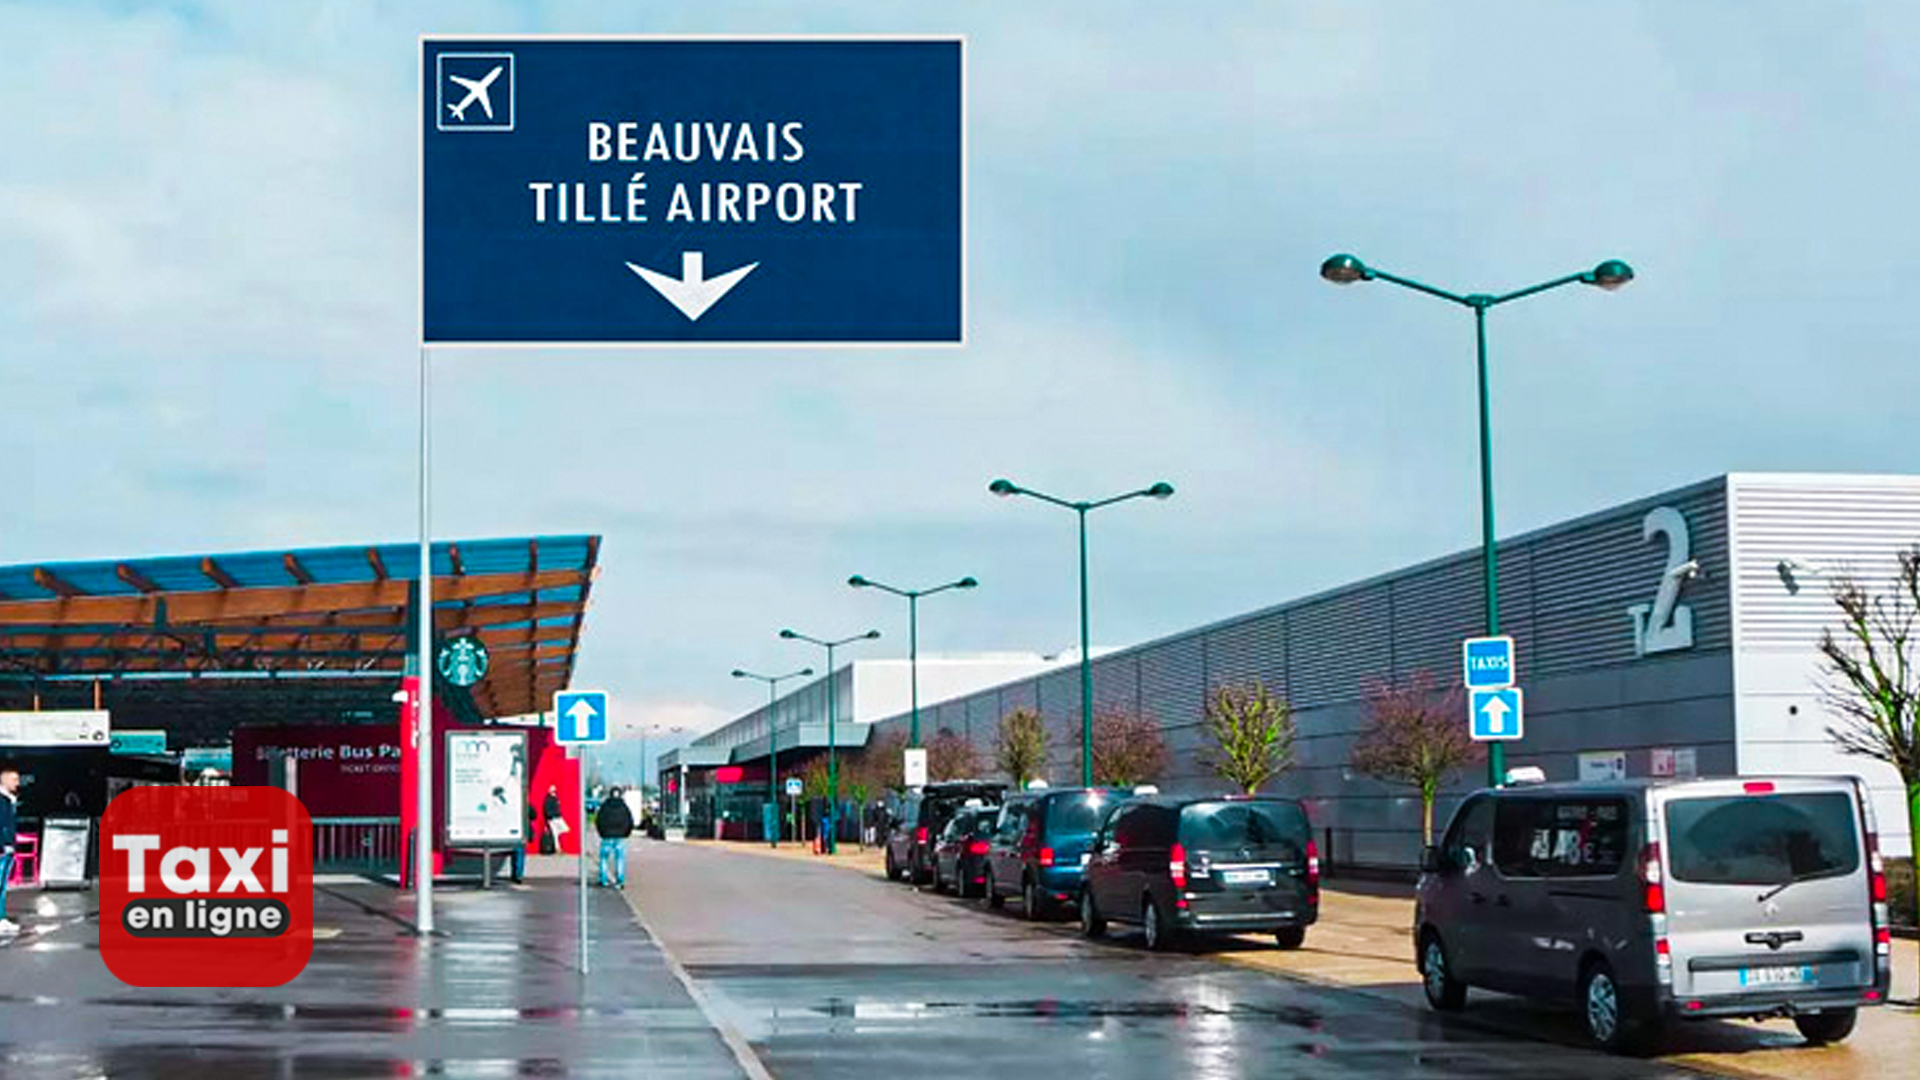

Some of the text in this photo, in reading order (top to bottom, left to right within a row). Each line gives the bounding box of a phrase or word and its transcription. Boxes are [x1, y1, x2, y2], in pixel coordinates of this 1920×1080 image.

[587, 121, 805, 163] BEAUVAIS
[529, 172, 864, 223] TILLÉ AIRPORT
[1470, 655, 1509, 671] TAXIS
[339, 744, 374, 760] Bus
[378, 743, 401, 759] Pa
